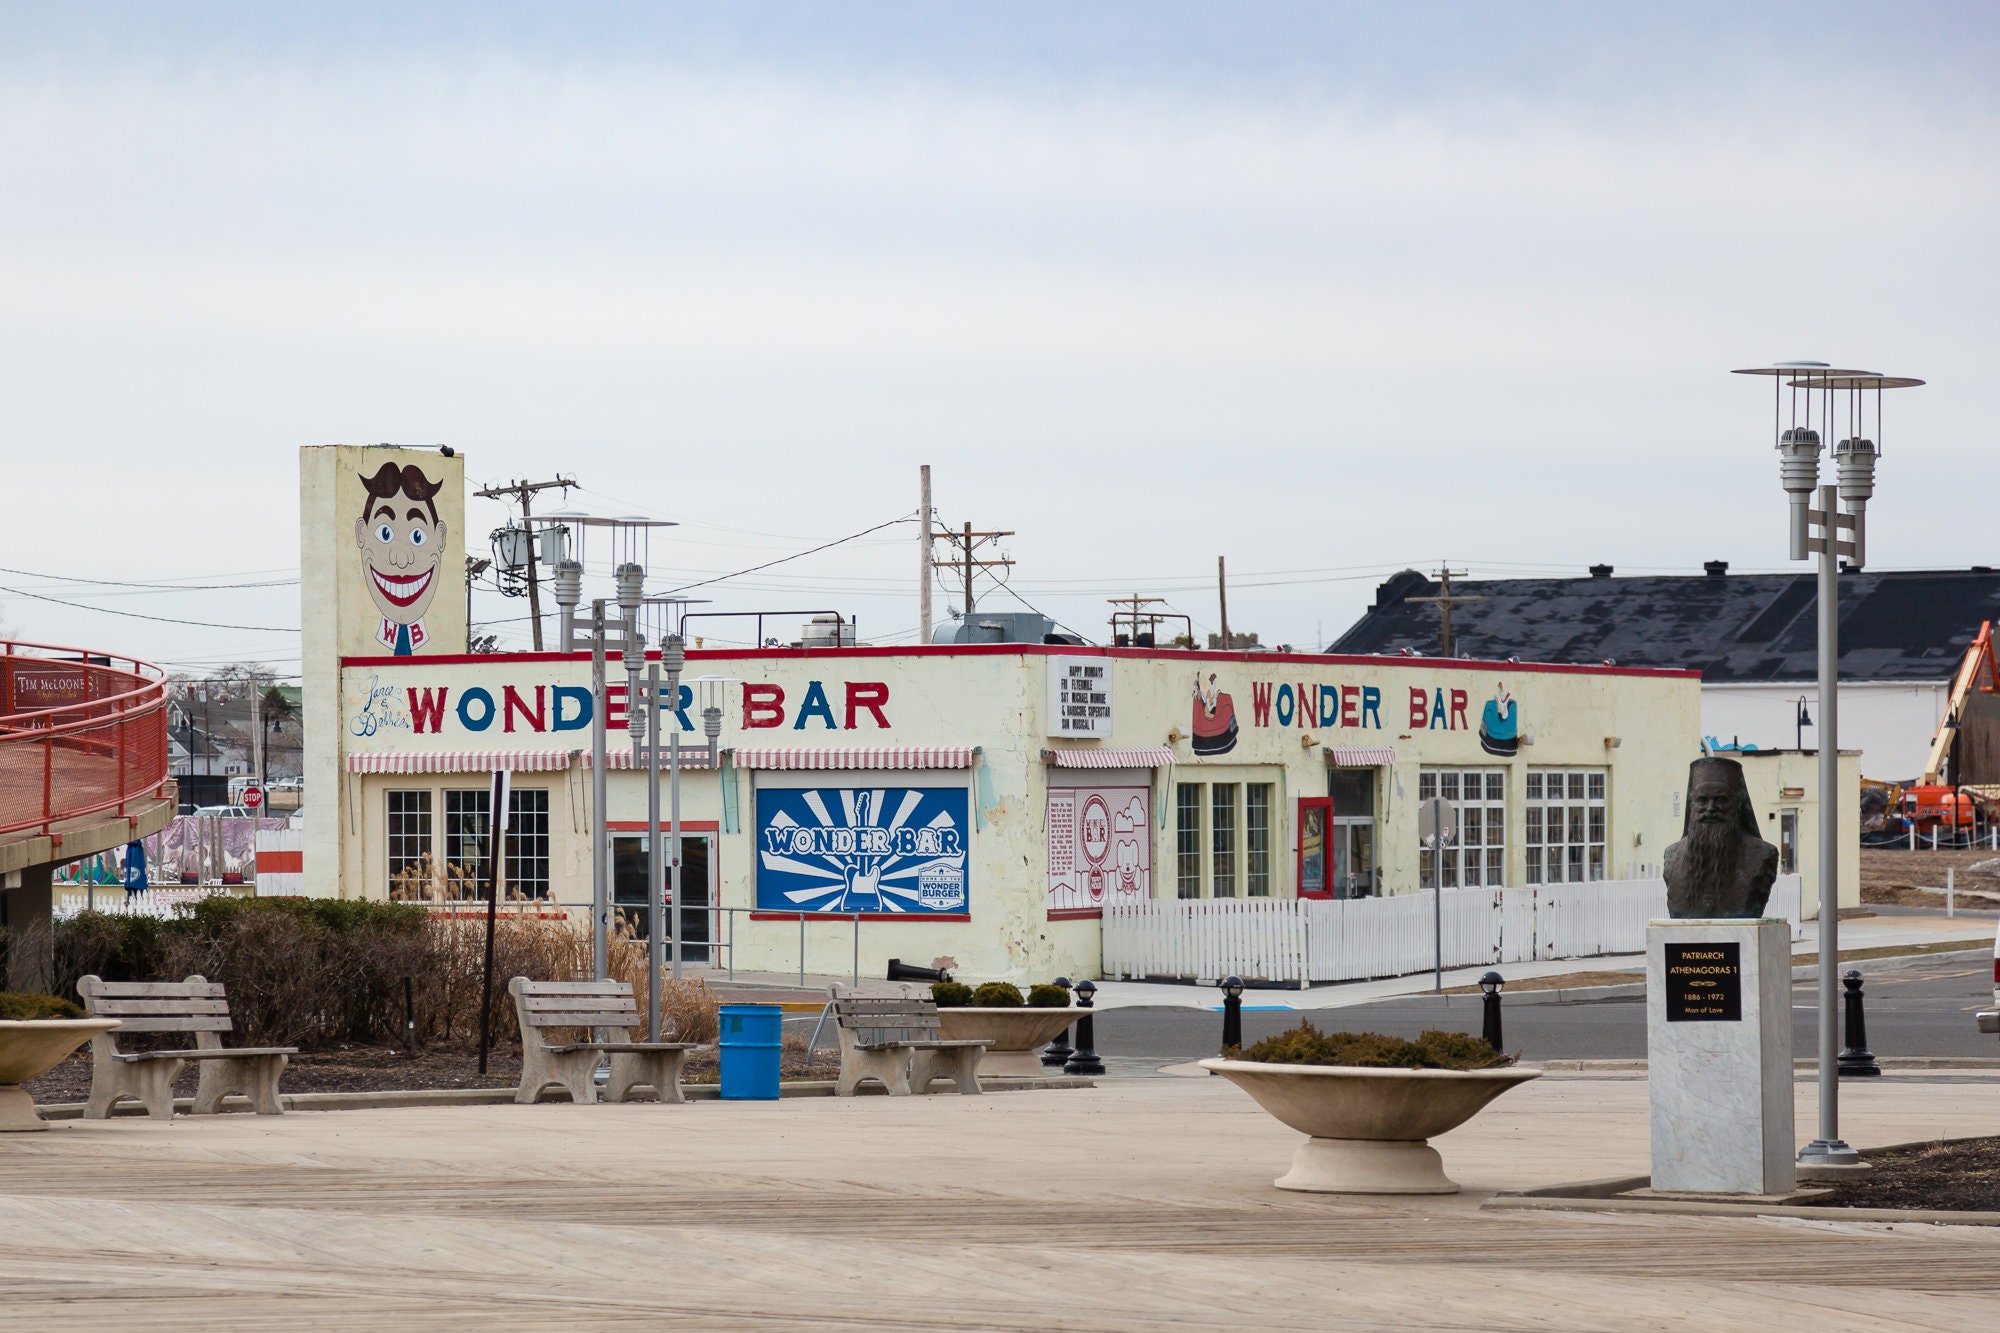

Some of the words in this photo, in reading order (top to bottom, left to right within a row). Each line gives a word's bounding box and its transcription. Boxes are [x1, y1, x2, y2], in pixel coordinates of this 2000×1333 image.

[382, 618, 398, 645] W
[409, 623, 424, 646] B
[1069, 666, 1082, 677] HAPPY
[1084, 666, 1103, 678] MONDAYS
[1061, 692, 1069, 703] SAT
[1071, 692, 1088, 704] MICHAEL
[1090, 693, 1106, 704] MONROE
[406, 684, 695, 734] WONDER
[740, 680, 891, 730] BAR
[1067, 705, 1086, 717] HARDCORE
[1088, 706, 1110, 718] SUPERSTAR
[1252, 682, 1381, 729] WONDER
[1409, 686, 1468, 730] BAR
[244, 793, 261, 802] STOP
[766, 827, 891, 856] WONDER
[896, 828, 962, 857] BAR
[1670, 966, 1731, 974] ATHENAGORAS
